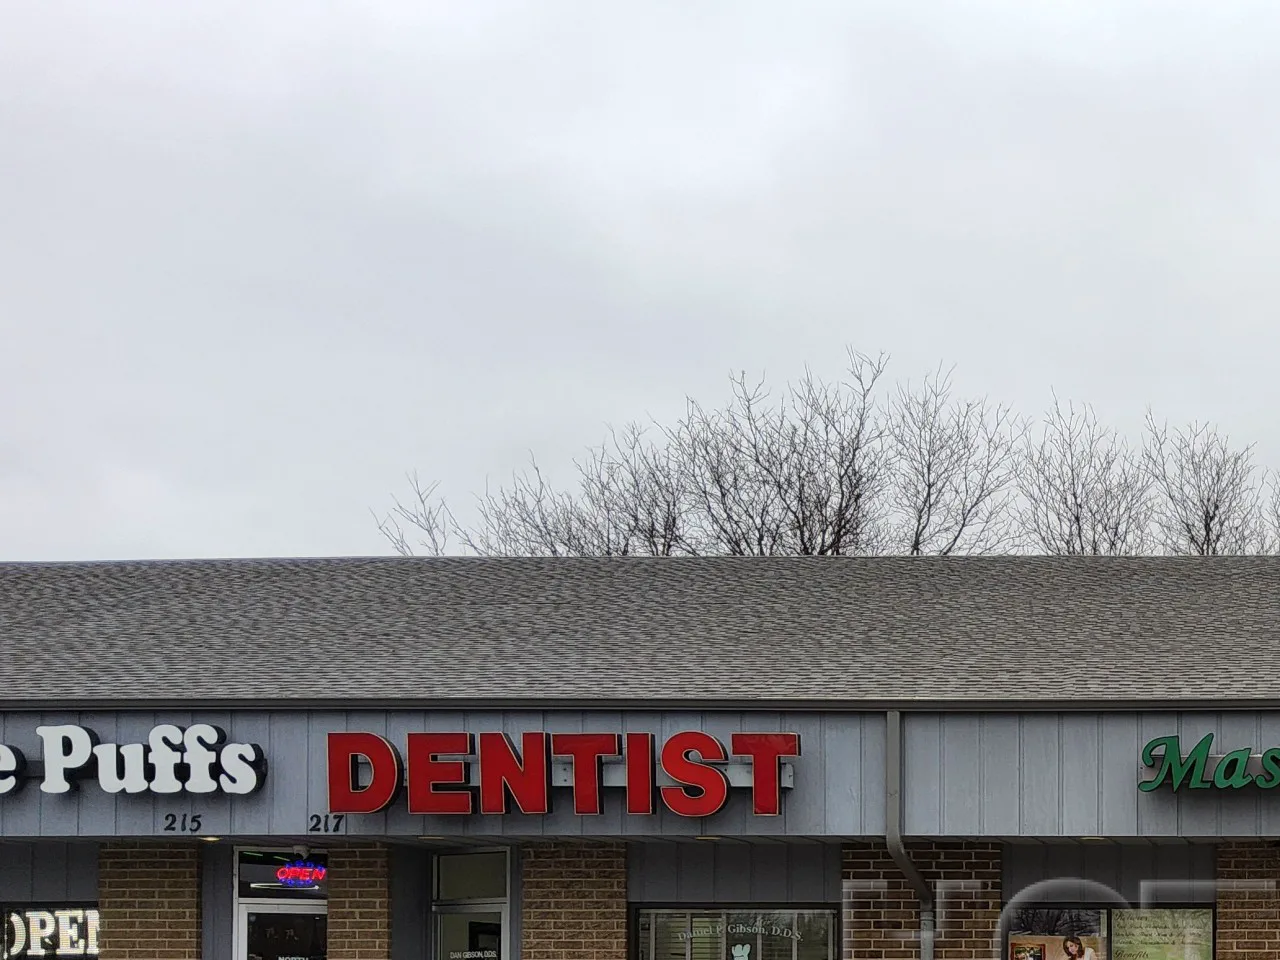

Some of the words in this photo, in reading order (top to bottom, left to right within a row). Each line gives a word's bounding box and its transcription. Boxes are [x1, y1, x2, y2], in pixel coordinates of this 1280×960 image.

[36, 724, 258, 794] Puffs
[327, 731, 799, 816] DENTIST
[164, 813, 202, 832] 215
[309, 814, 344, 832] 217
[276, 866, 327, 881] OPEN
[728, 923, 769, 935] Gibson,
[772, 926, 804, 942] D.D.S.
[450, 951, 462, 959] DAN
